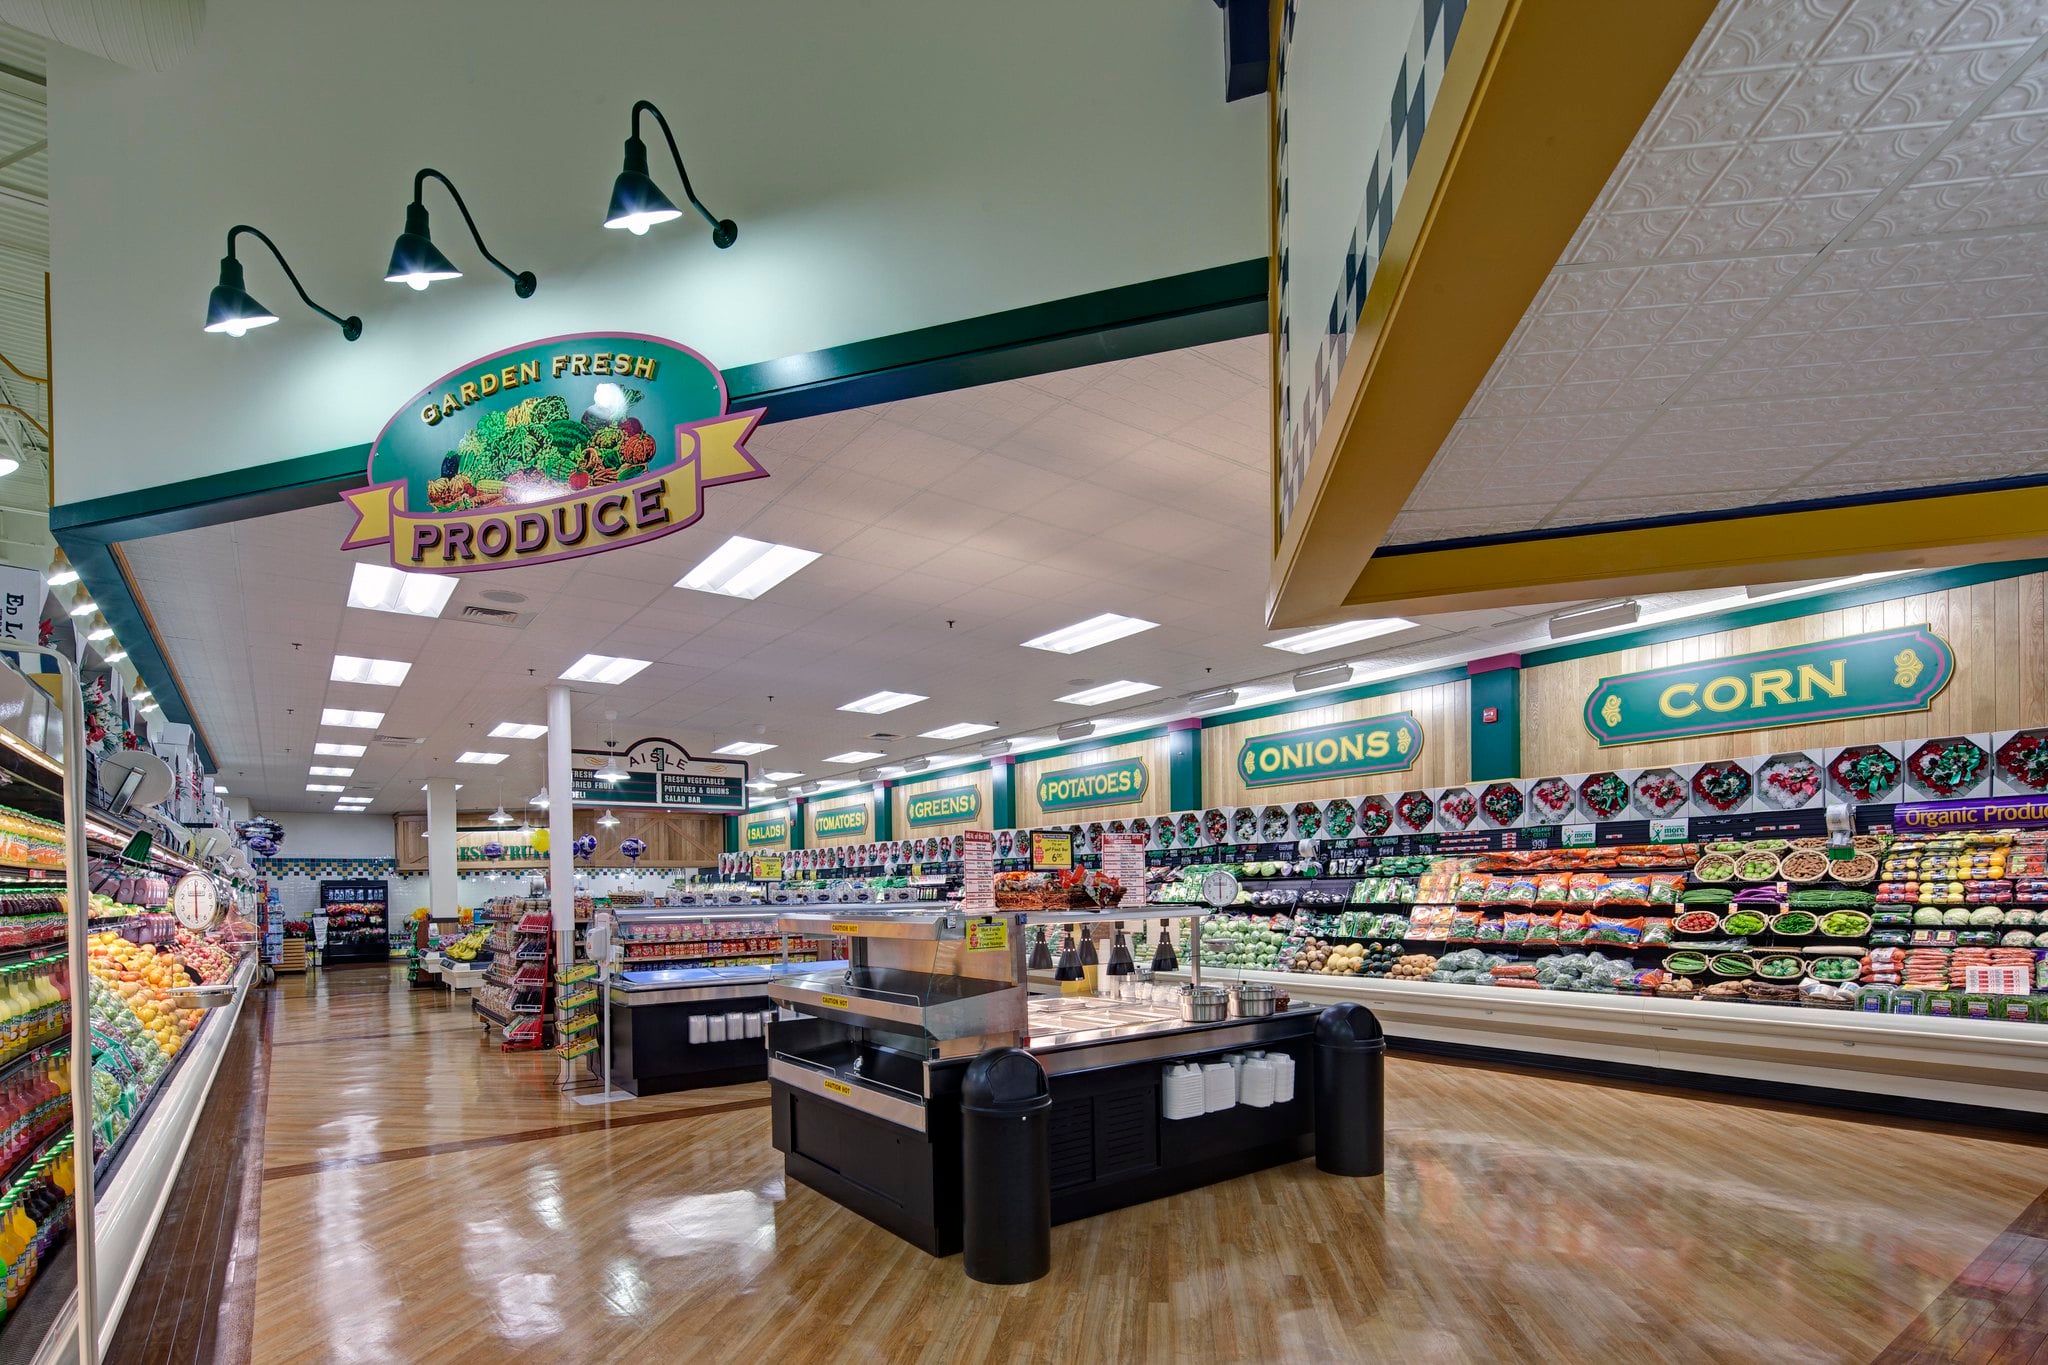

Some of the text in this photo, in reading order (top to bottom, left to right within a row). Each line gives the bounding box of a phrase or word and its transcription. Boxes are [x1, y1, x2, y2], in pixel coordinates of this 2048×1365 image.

[420, 353, 658, 426] GARDEN FRESH
[411, 479, 669, 561] PRODUCE
[1658, 658, 1847, 718] CORN
[629, 750, 688, 771] AISLE
[1259, 731, 1390, 772] ONIONS
[594, 782, 614, 790] FRUIT
[664, 776, 726, 786] FRESH VEGETABLES
[664, 785, 696, 794] POTATOES
[706, 787, 730, 795] ONIONS
[1048, 771, 1131, 801] POTATOES
[664, 795, 701, 804] SALAD BAR
[914, 795, 969, 818] GREENS
[818, 812, 861, 831] TOMATOES
[1905, 807, 1978, 828] Organic
[752, 826, 781, 840] SALADS
[832, 924, 848, 932] CAUTION
[823, 996, 839, 1005] CAUTION
[825, 1080, 850, 1095] CAUTION HOT
